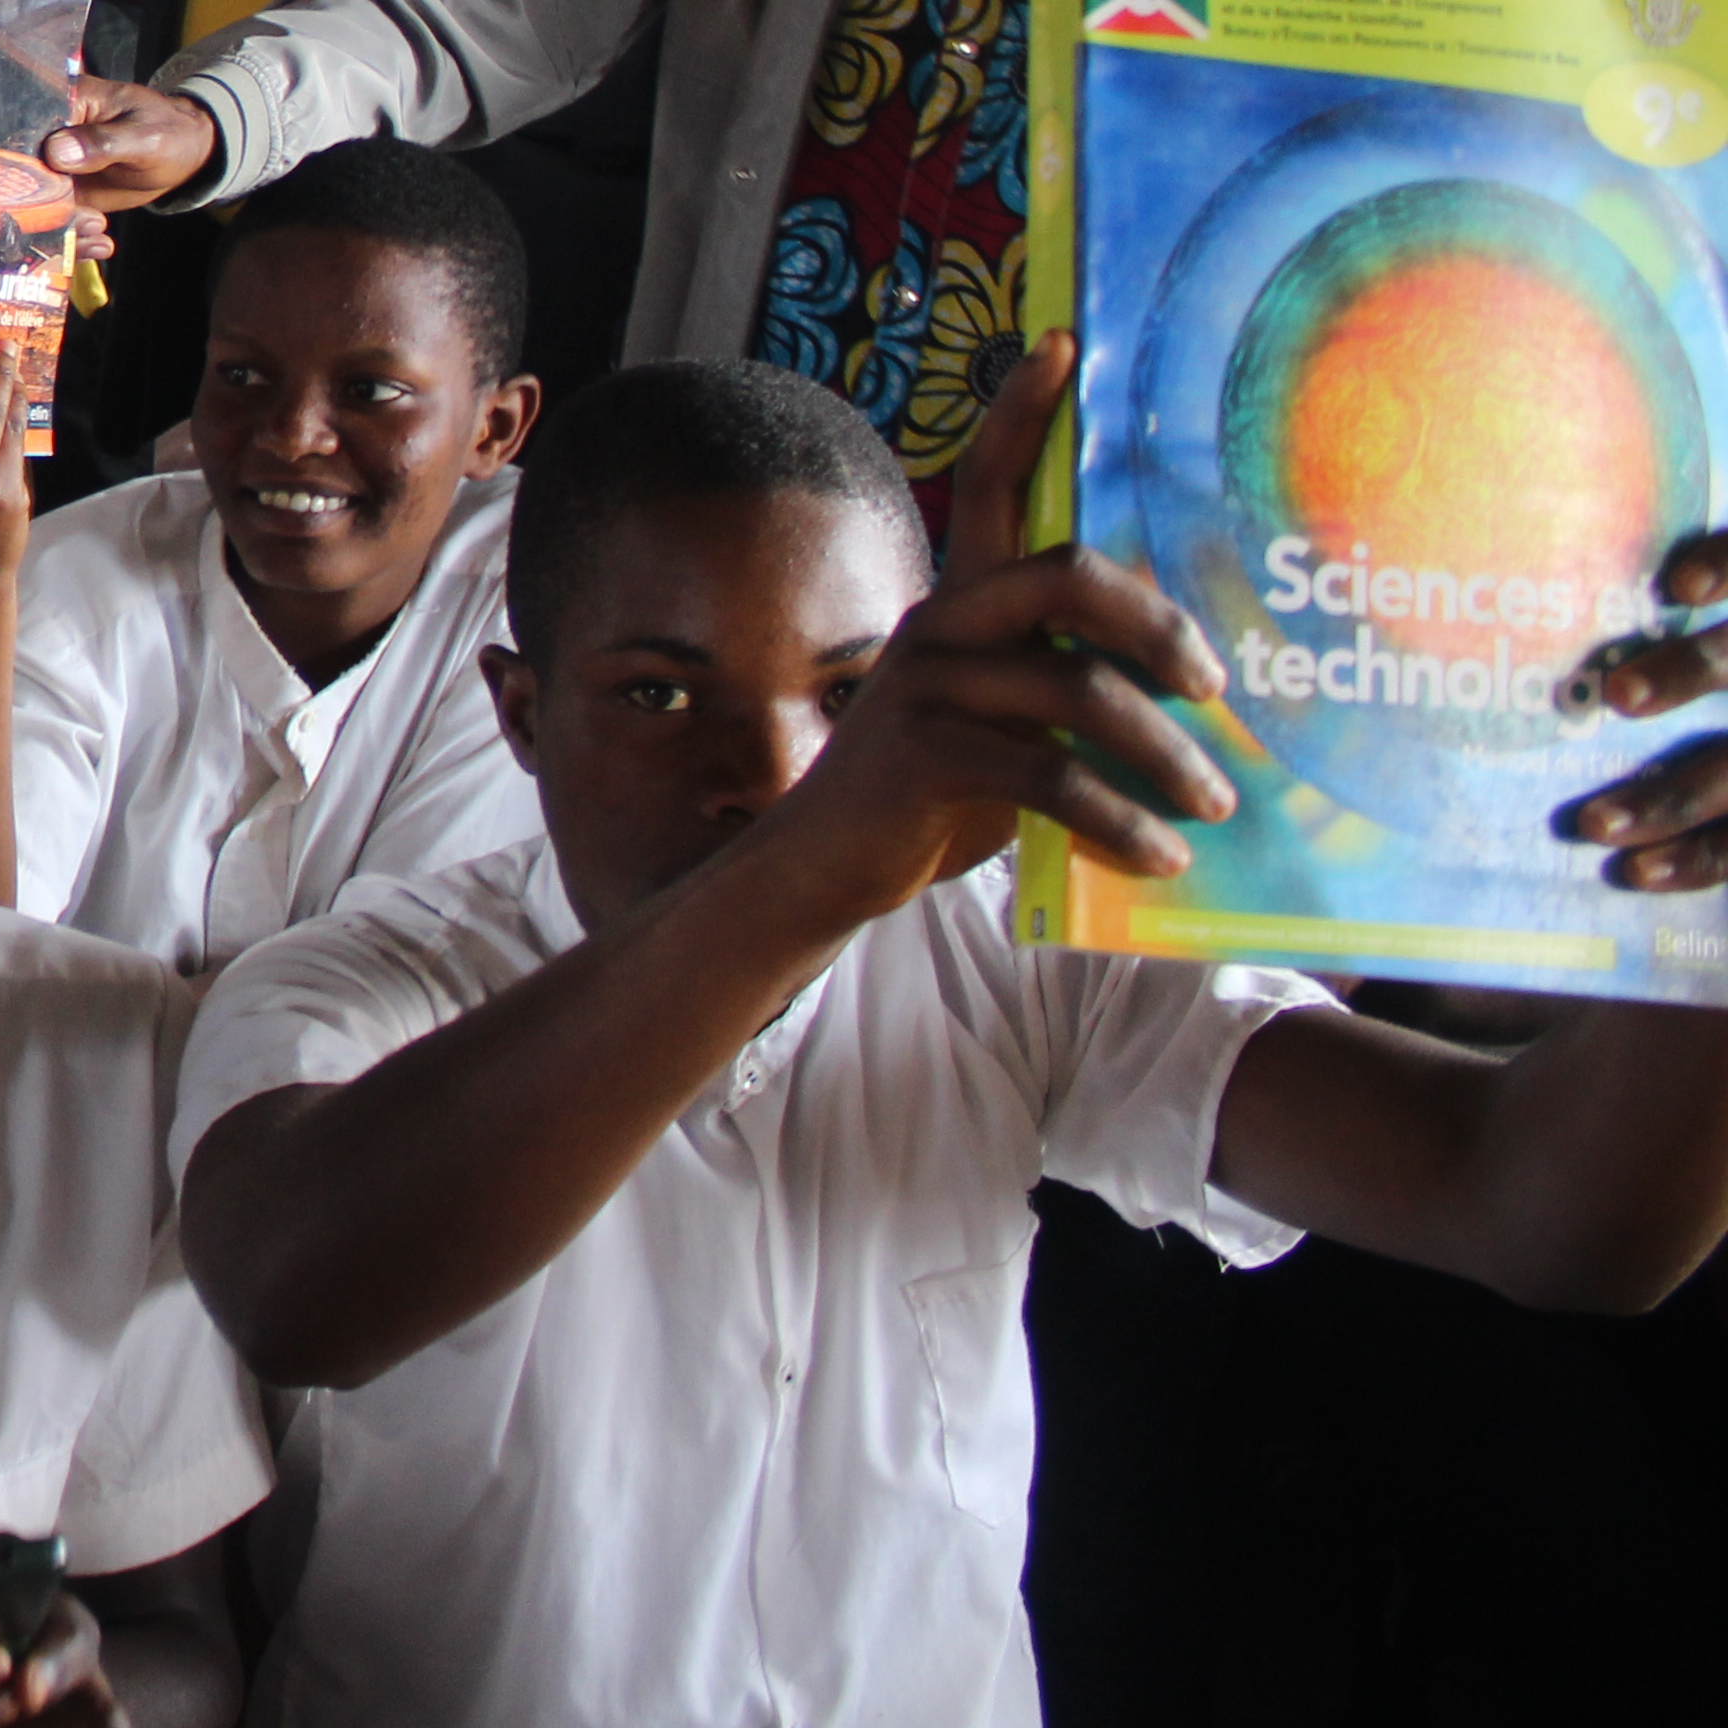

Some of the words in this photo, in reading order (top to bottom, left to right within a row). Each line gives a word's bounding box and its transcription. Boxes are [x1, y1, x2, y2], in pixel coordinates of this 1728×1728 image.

[1633, 83, 1701, 150] 9e
[0, 312, 13, 326] de
[14, 310, 45, 328] l'élève
[26, 405, 49, 421] elin
[1263, 534, 1575, 631] Sciences
[1654, 927, 1718, 959] Belin
